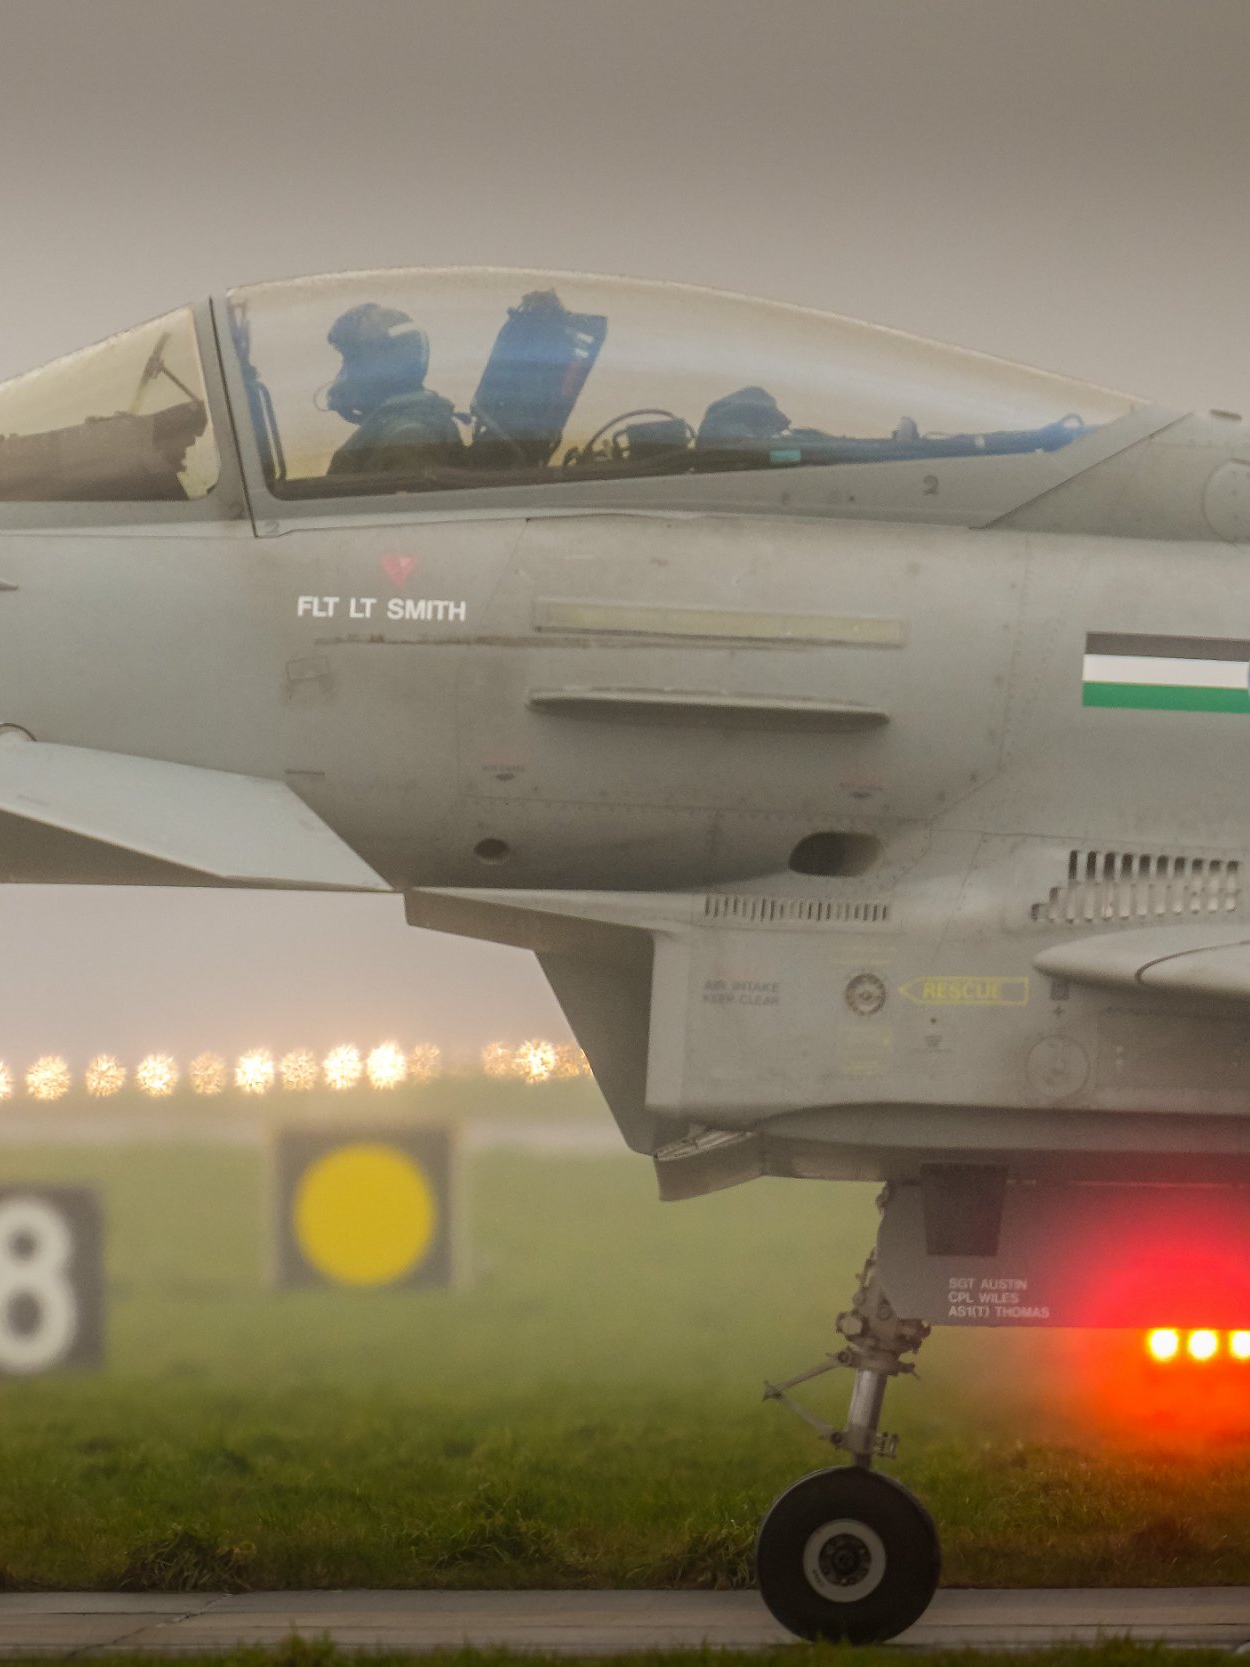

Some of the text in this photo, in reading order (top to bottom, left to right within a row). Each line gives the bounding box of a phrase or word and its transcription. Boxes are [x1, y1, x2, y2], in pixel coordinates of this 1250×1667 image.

[297, 595, 467, 622] FLT LT SMITH
[921, 982, 1001, 999] RESCUE
[948, 1277, 1028, 1290] SGT AUSTIN
[948, 1291, 1020, 1304] CPL WILES
[994, 1306, 1050, 1319] THOMAS
